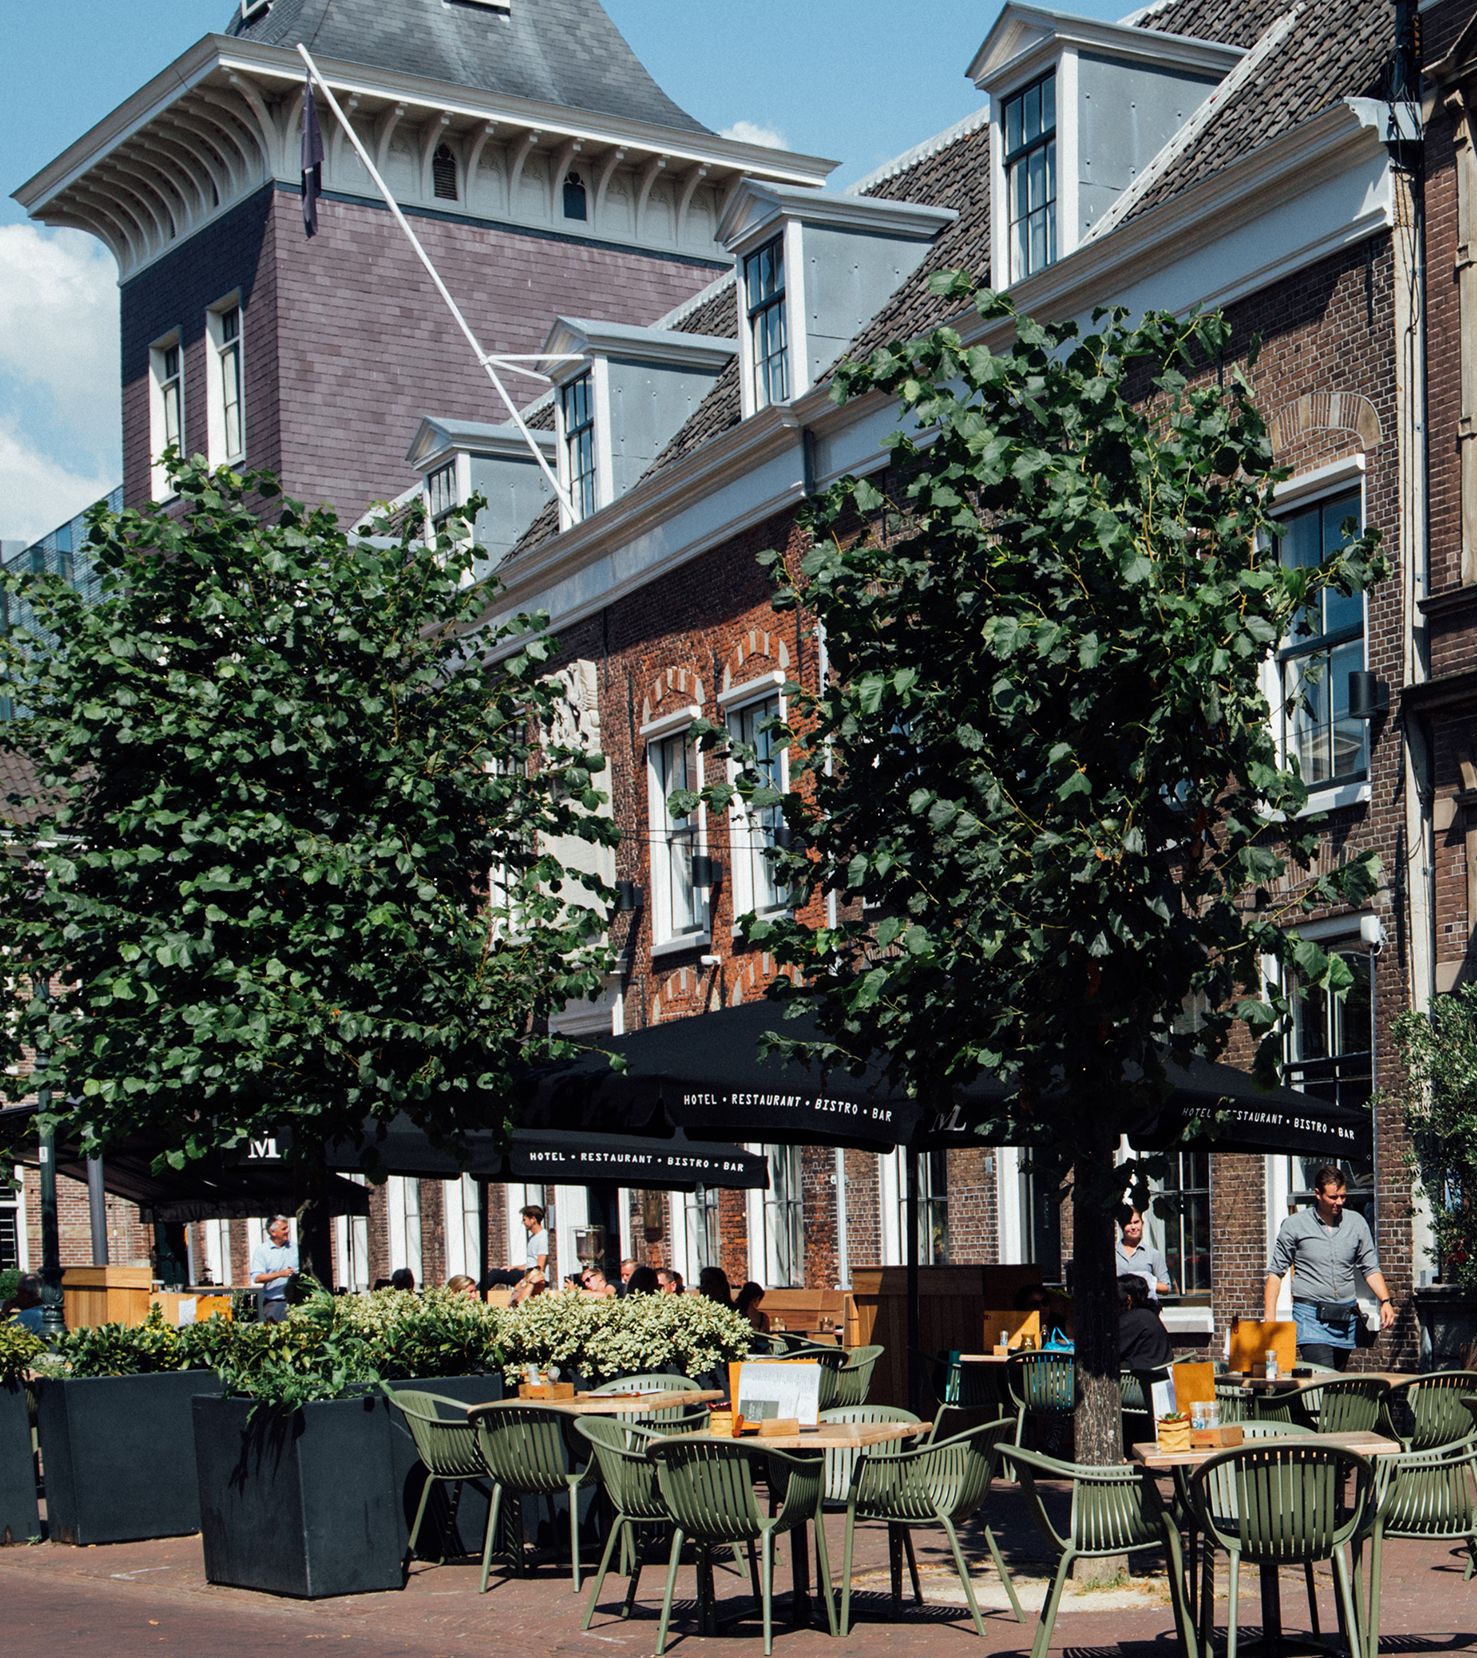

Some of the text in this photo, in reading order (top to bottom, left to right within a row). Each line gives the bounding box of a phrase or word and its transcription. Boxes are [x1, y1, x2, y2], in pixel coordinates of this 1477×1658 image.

[683, 1093, 892, 1123] HOTEL RESTAURANT BISTRO BAR
[1225, 1109, 1283, 1126] STAURANT
[1293, 1117, 1328, 1134] BISTRO
[1337, 1126, 1356, 1141] BAR
[529, 1151, 745, 1173] HOTEL RESTAURANT BISTRO BAR
